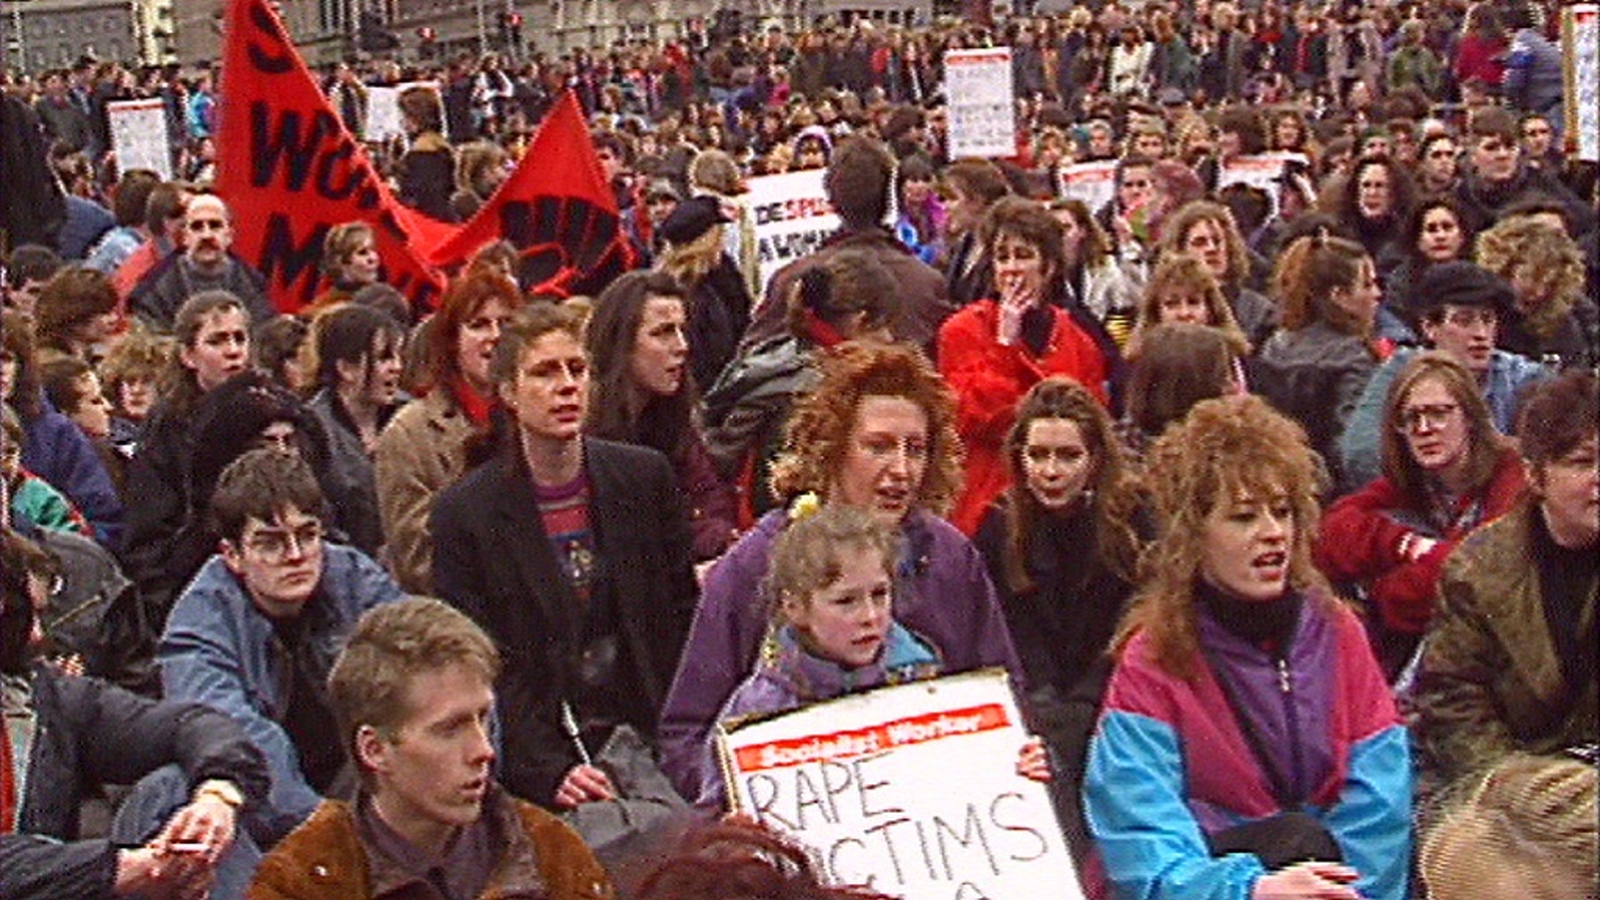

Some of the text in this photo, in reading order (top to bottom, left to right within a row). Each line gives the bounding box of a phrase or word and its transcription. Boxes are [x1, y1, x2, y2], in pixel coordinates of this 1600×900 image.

[246, 2, 297, 74] S
[762, 714, 982, 768] Socialist Worker
[746, 751, 905, 830] RAPE
[778, 792, 1048, 886] ICTIMS
